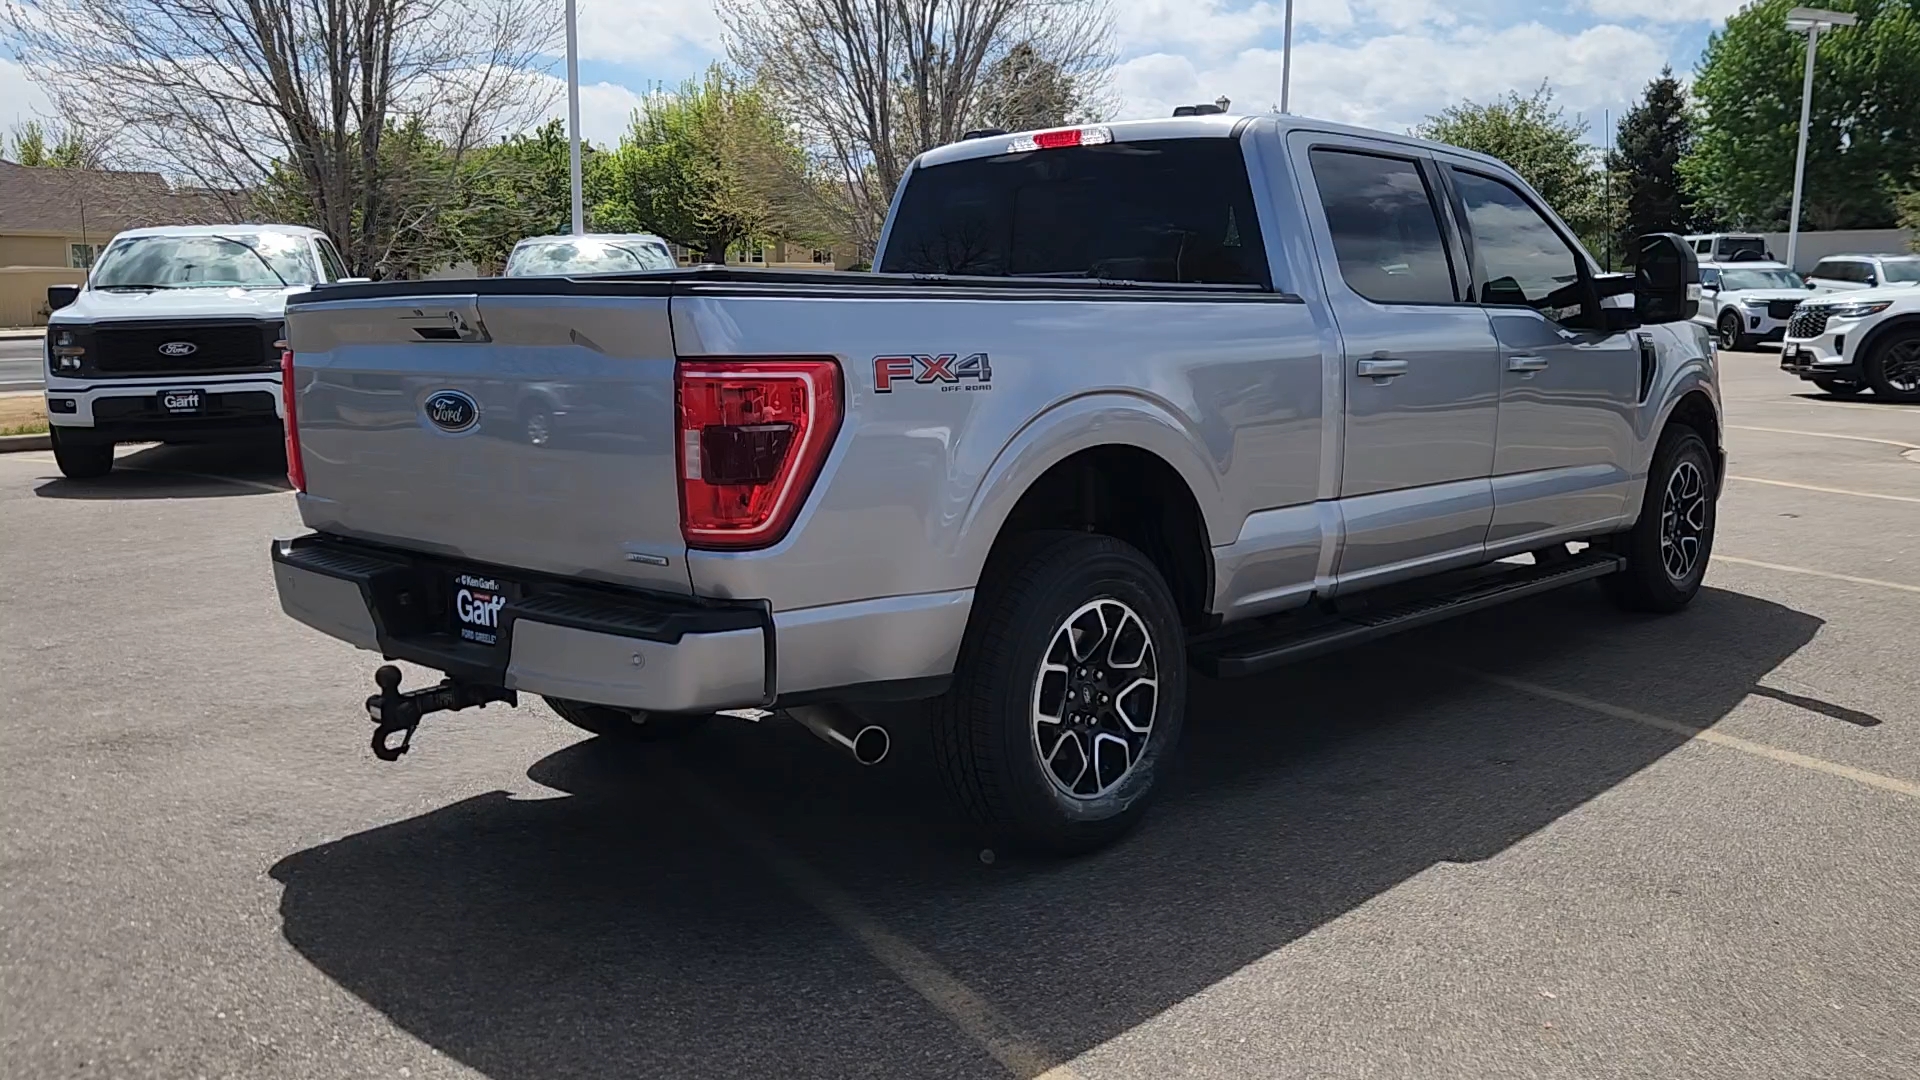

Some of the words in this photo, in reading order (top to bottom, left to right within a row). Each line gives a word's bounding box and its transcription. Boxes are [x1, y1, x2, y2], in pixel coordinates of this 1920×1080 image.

[166, 343, 189, 354] Ford
[872, 353, 992, 394] FX4
[164, 394, 199, 408] Garff
[433, 398, 463, 422] Ford
[466, 575, 479, 588] Ken
